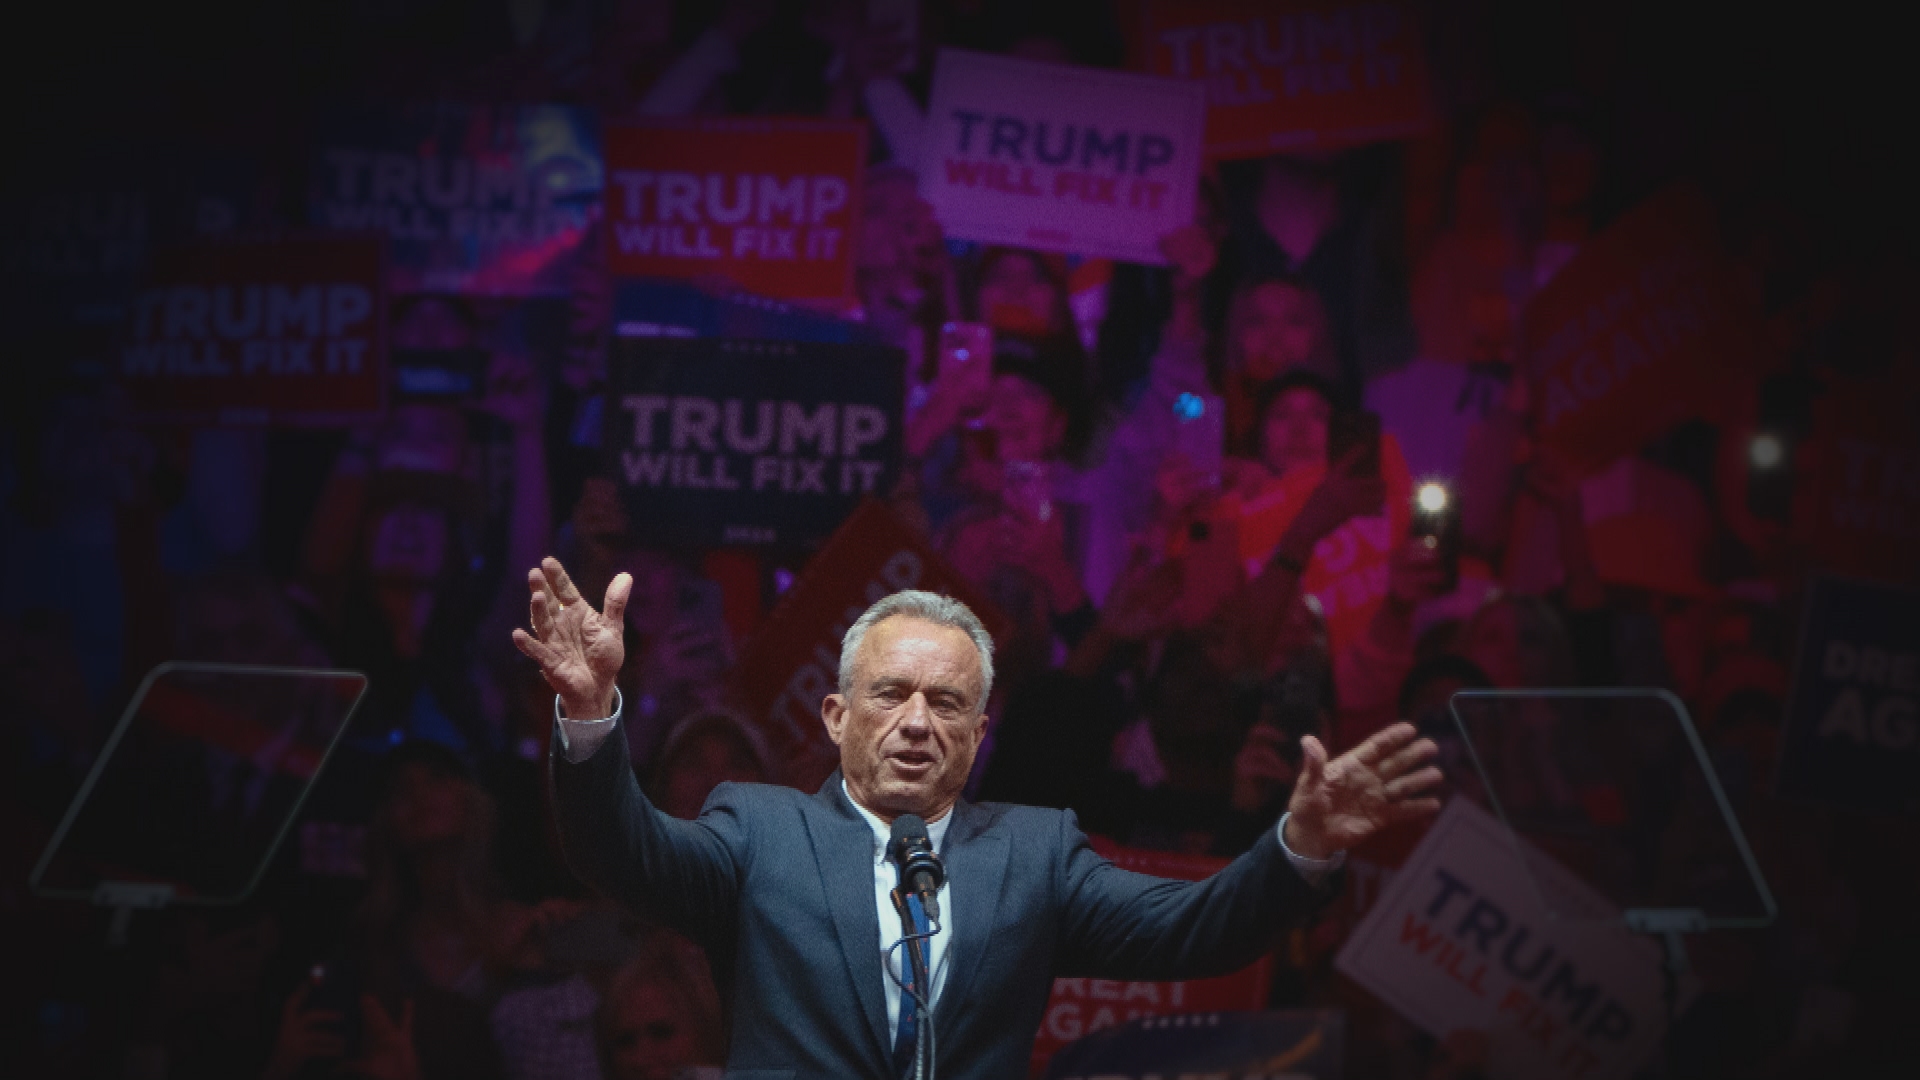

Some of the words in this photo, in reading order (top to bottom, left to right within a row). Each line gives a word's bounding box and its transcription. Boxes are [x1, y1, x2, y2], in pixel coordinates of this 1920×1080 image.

[1161, 5, 1399, 78] TRUMP
[1205, 72, 1276, 105] ILL
[1282, 60, 1353, 97] FIX
[1363, 54, 1402, 87] IT
[951, 109, 1175, 175] TRUMP
[612, 170, 848, 224] TRUMP
[945, 158, 1043, 197] WILL
[1053, 171, 1117, 207] FIX
[1129, 179, 1169, 210] IT
[613, 221, 721, 259] WILL
[731, 227, 798, 261] FIX
[804, 227, 842, 262] IT
[130, 282, 374, 340] TRUMP
[120, 335, 234, 378] WILL
[240, 338, 316, 378] FIX
[322, 338, 369, 378] IT
[620, 394, 889, 458] TRUMP
[620, 449, 742, 491] WILL
[751, 454, 827, 494] FIX
[838, 458, 885, 496] IT
[770, 549, 923, 742] TRP
[1426, 867, 1634, 1042] TRUMP
[1399, 912, 1490, 999] WILL
[1497, 984, 1572, 1048] FIX
[1559, 1041, 1603, 1080] IT
